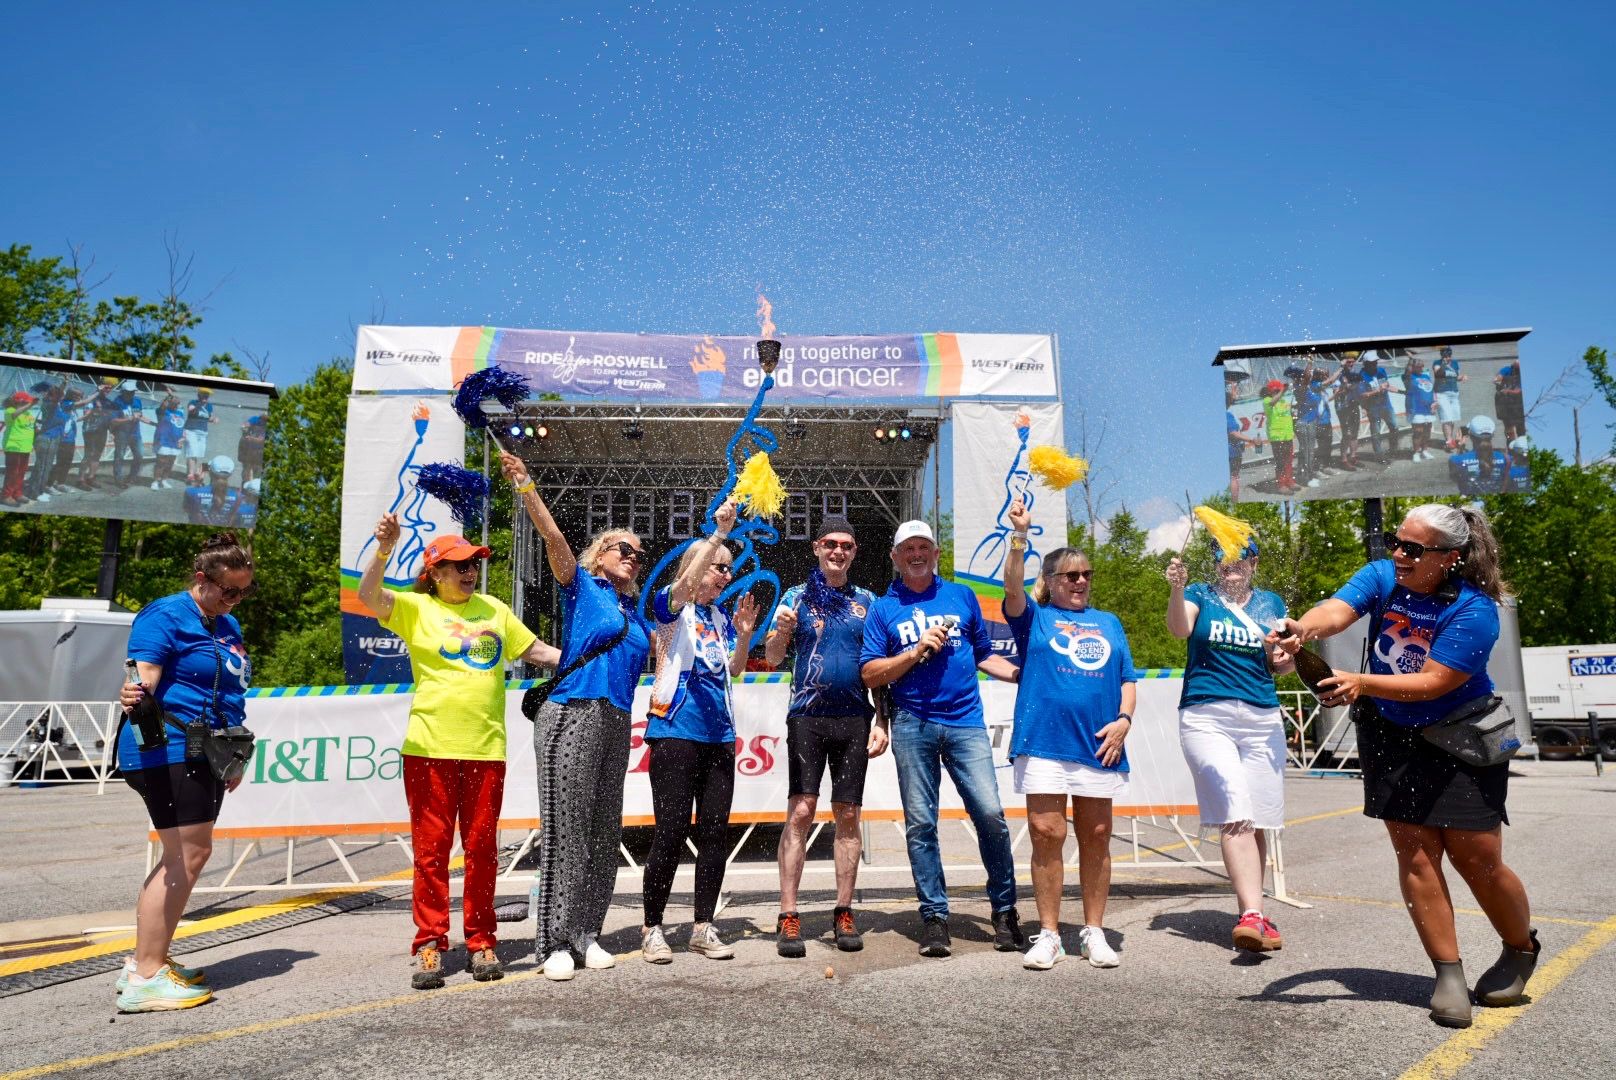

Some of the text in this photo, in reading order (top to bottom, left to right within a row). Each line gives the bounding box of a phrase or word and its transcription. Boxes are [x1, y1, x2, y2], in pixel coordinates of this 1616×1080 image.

[525, 351, 563, 364] RIDE
[593, 354, 667, 369] ROSWELL
[743, 344, 902, 363] rig together to
[971, 359, 1009, 368] WEST
[620, 369, 648, 377] CANCER
[802, 367, 903, 387] cancer.
[1208, 616, 1262, 648] RIDE
[359, 637, 402, 649] WEST
